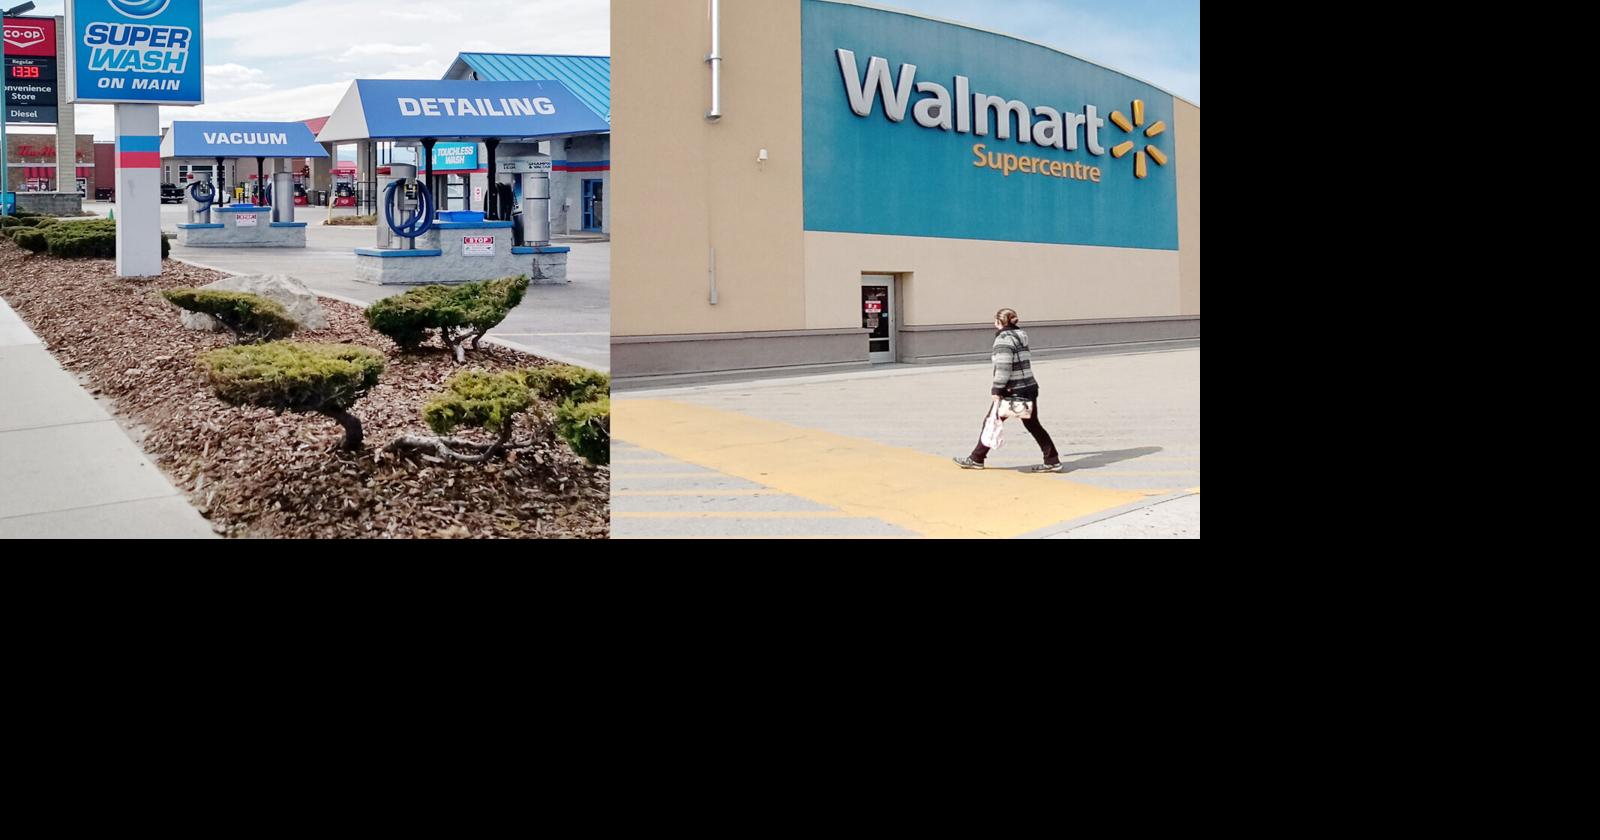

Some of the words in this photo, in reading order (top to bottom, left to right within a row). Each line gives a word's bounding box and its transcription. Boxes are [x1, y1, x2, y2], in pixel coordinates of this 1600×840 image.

[86, 23, 190, 49] SUPER
[91, 48, 186, 72] WASH
[97, 77, 125, 89] ON
[132, 78, 180, 91] MAIN
[11, 92, 36, 101] Store
[835, 48, 1105, 156] Walmart
[397, 96, 556, 117] DETAILING
[10, 110, 38, 118] Diesel
[203, 132, 288, 145] VACUUM
[437, 146, 474, 157] TOUCHLESS
[445, 155, 465, 165] WASH
[972, 143, 1101, 182] Supercentre
